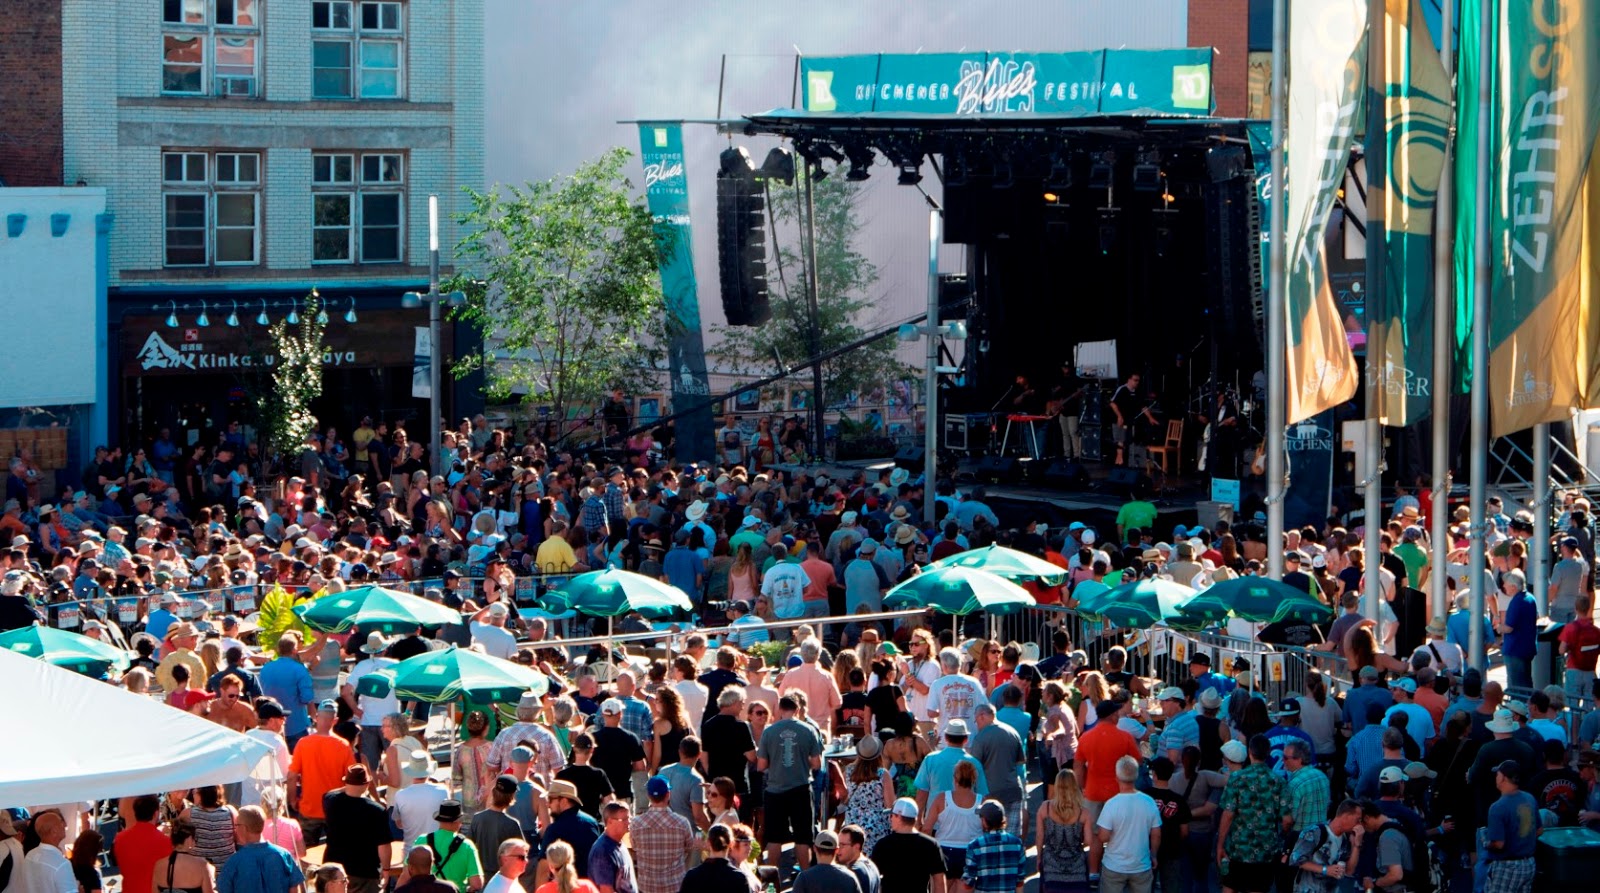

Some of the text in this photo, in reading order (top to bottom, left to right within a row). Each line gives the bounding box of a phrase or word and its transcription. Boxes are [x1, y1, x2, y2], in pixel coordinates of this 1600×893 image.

[953, 57, 1037, 114] Blues
[1176, 73, 1207, 100] TD
[644, 159, 683, 188] Blues
[1513, 86, 1568, 273] ZEHR
[199, 353, 274, 368] Kinkau
